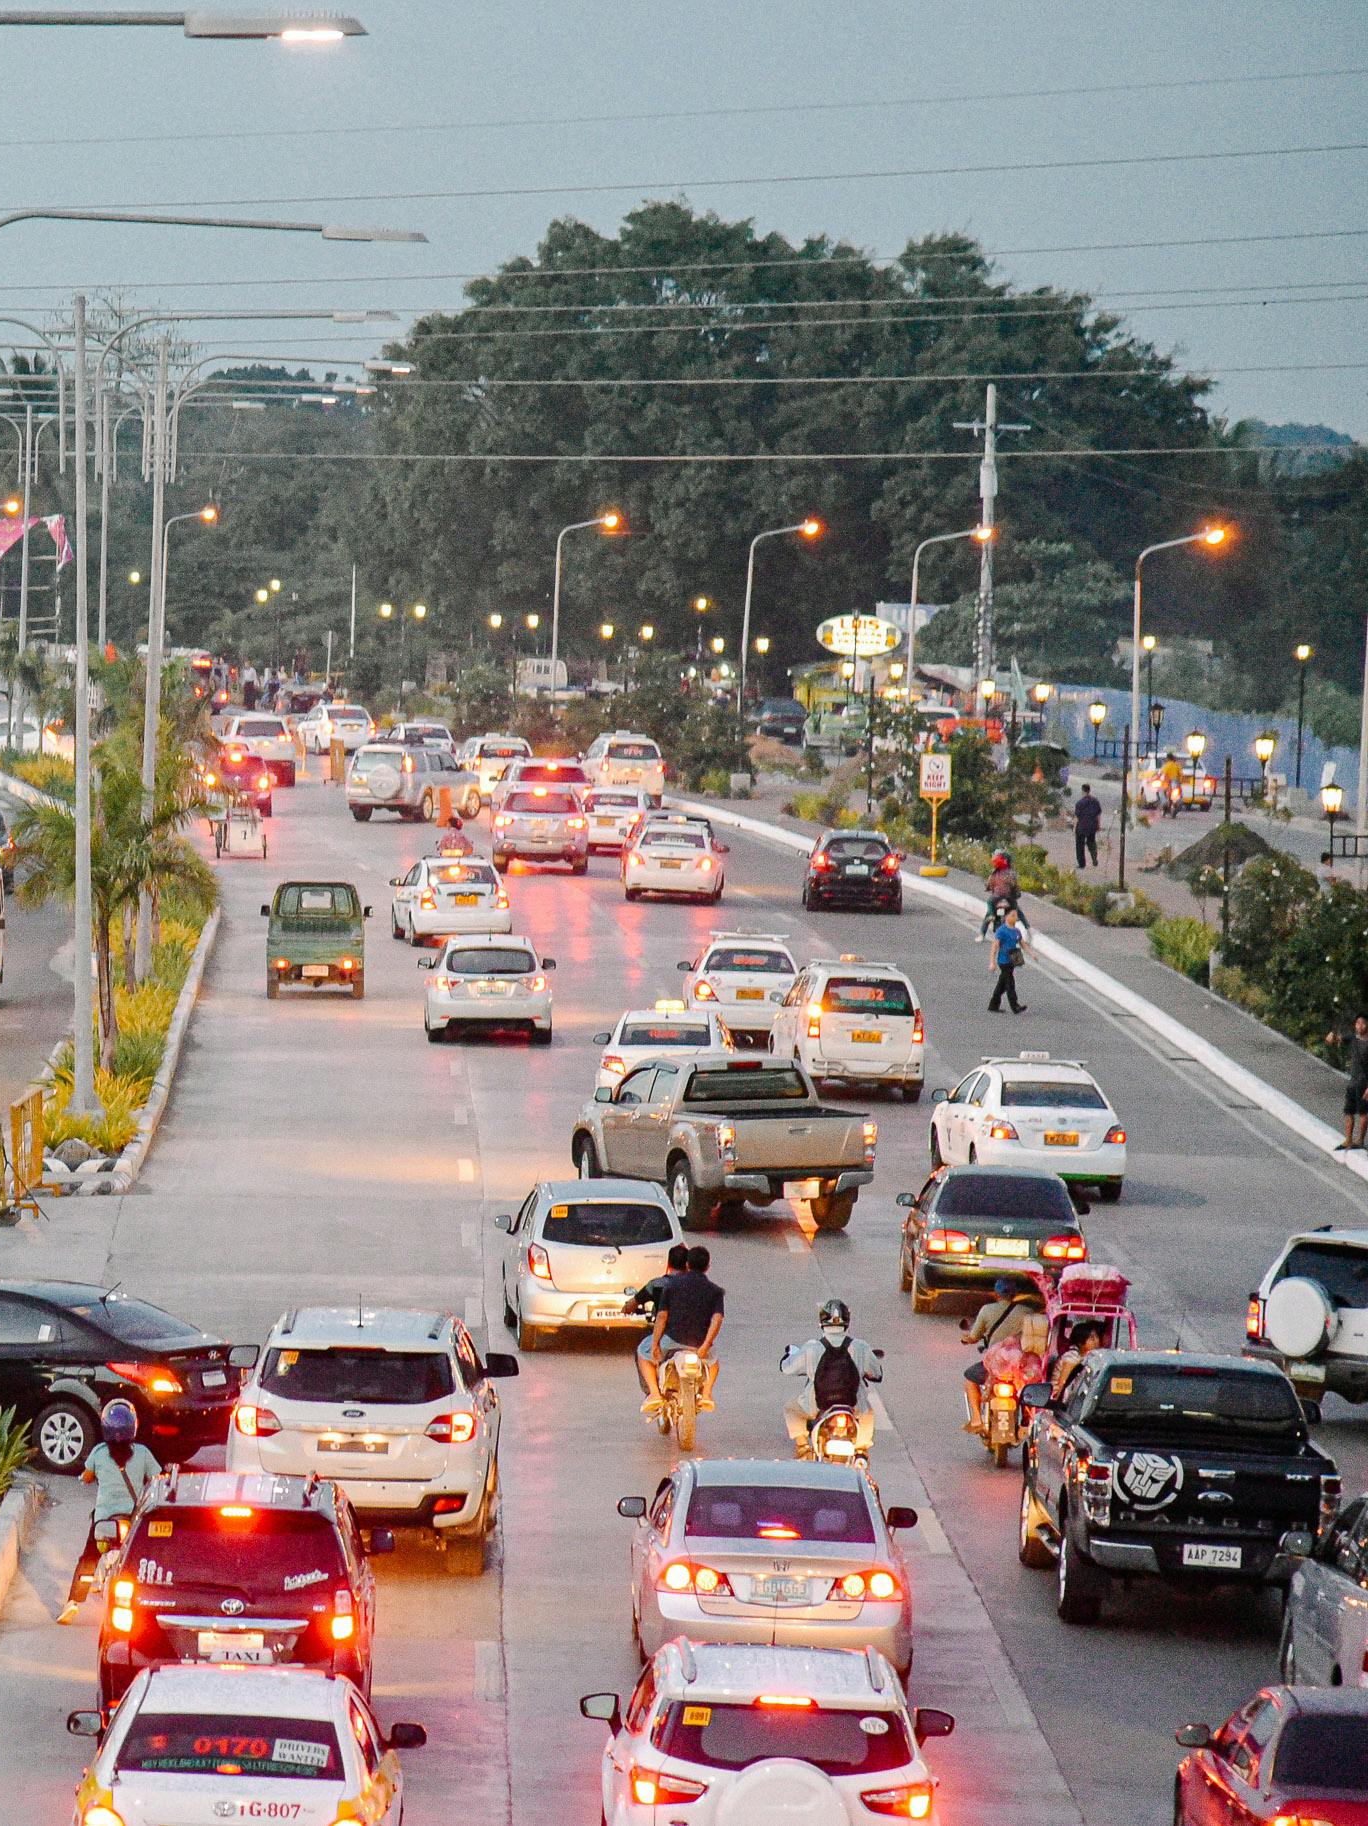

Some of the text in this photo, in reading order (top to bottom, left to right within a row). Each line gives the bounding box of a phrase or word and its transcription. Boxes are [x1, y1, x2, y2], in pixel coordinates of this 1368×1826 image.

[1187, 1549, 1238, 1561] AAP 7294
[224, 1652, 261, 1661] TAXI
